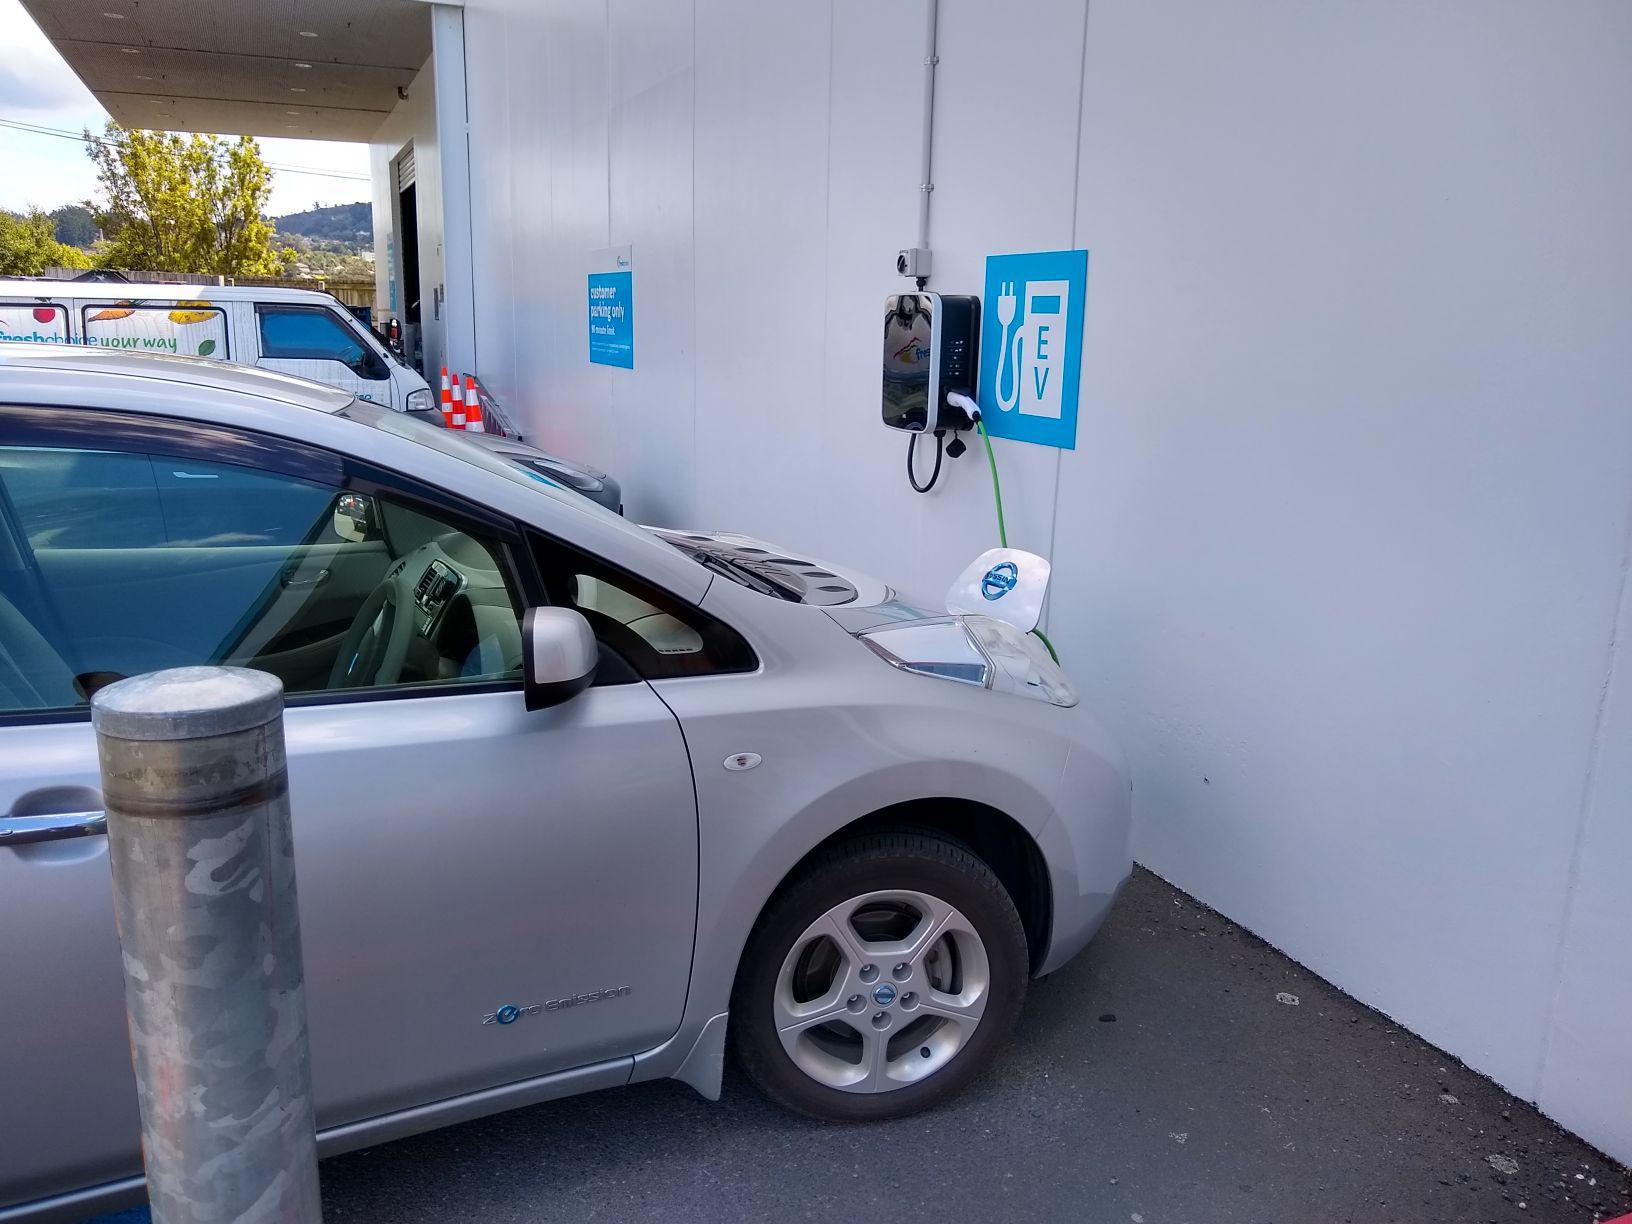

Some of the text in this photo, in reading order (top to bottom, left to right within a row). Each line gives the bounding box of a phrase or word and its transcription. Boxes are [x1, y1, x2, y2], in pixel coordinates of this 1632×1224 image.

[591, 285, 616, 299] customer
[591, 300, 625, 323] parking only
[100, 337, 140, 349] your
[143, 337, 177, 354] way
[545, 985, 632, 1011] emission
